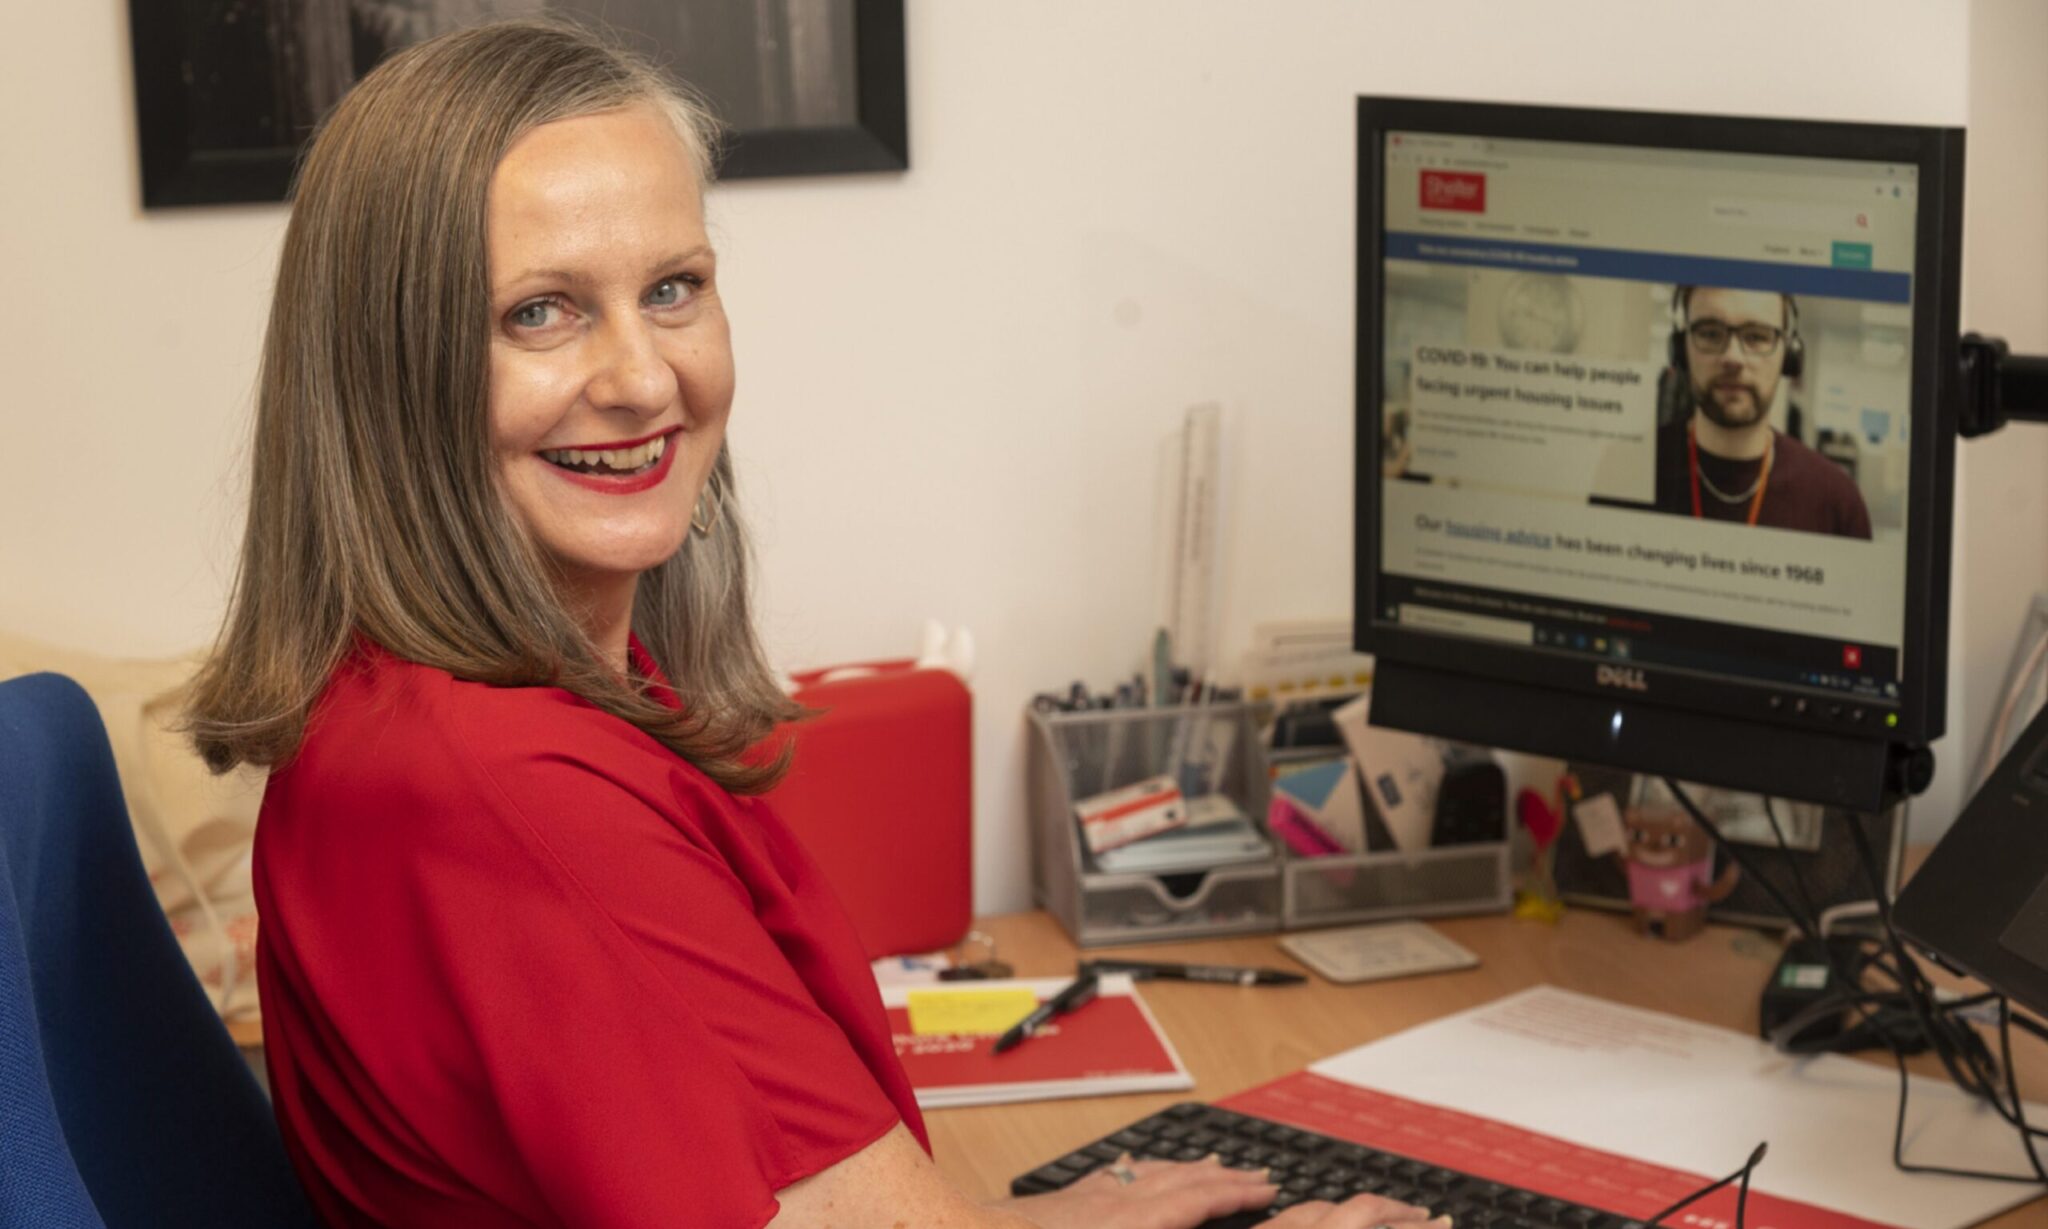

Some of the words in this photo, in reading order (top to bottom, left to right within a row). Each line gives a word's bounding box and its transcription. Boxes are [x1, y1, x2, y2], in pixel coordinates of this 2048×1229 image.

[1494, 354, 1521, 373] You
[1524, 360, 1550, 375] can
[1553, 361, 1586, 381] help
[1590, 368, 1642, 386] people
[1416, 376, 1461, 397] facing
[1465, 384, 1512, 402] urgent
[1515, 387, 1574, 411] housing
[1578, 393, 1624, 414] issues
[1415, 514, 1442, 532] Our
[1446, 519, 1501, 543] housing
[1506, 528, 1552, 549] advice
[1556, 532, 1582, 550] has
[1585, 537, 1623, 557] been
[1627, 543, 1697, 571] changing
[1701, 553, 1737, 573] lives
[1741, 557, 1781, 580] since
[1785, 563, 1825, 586] 1968
[1596, 664, 1648, 692] DELL
